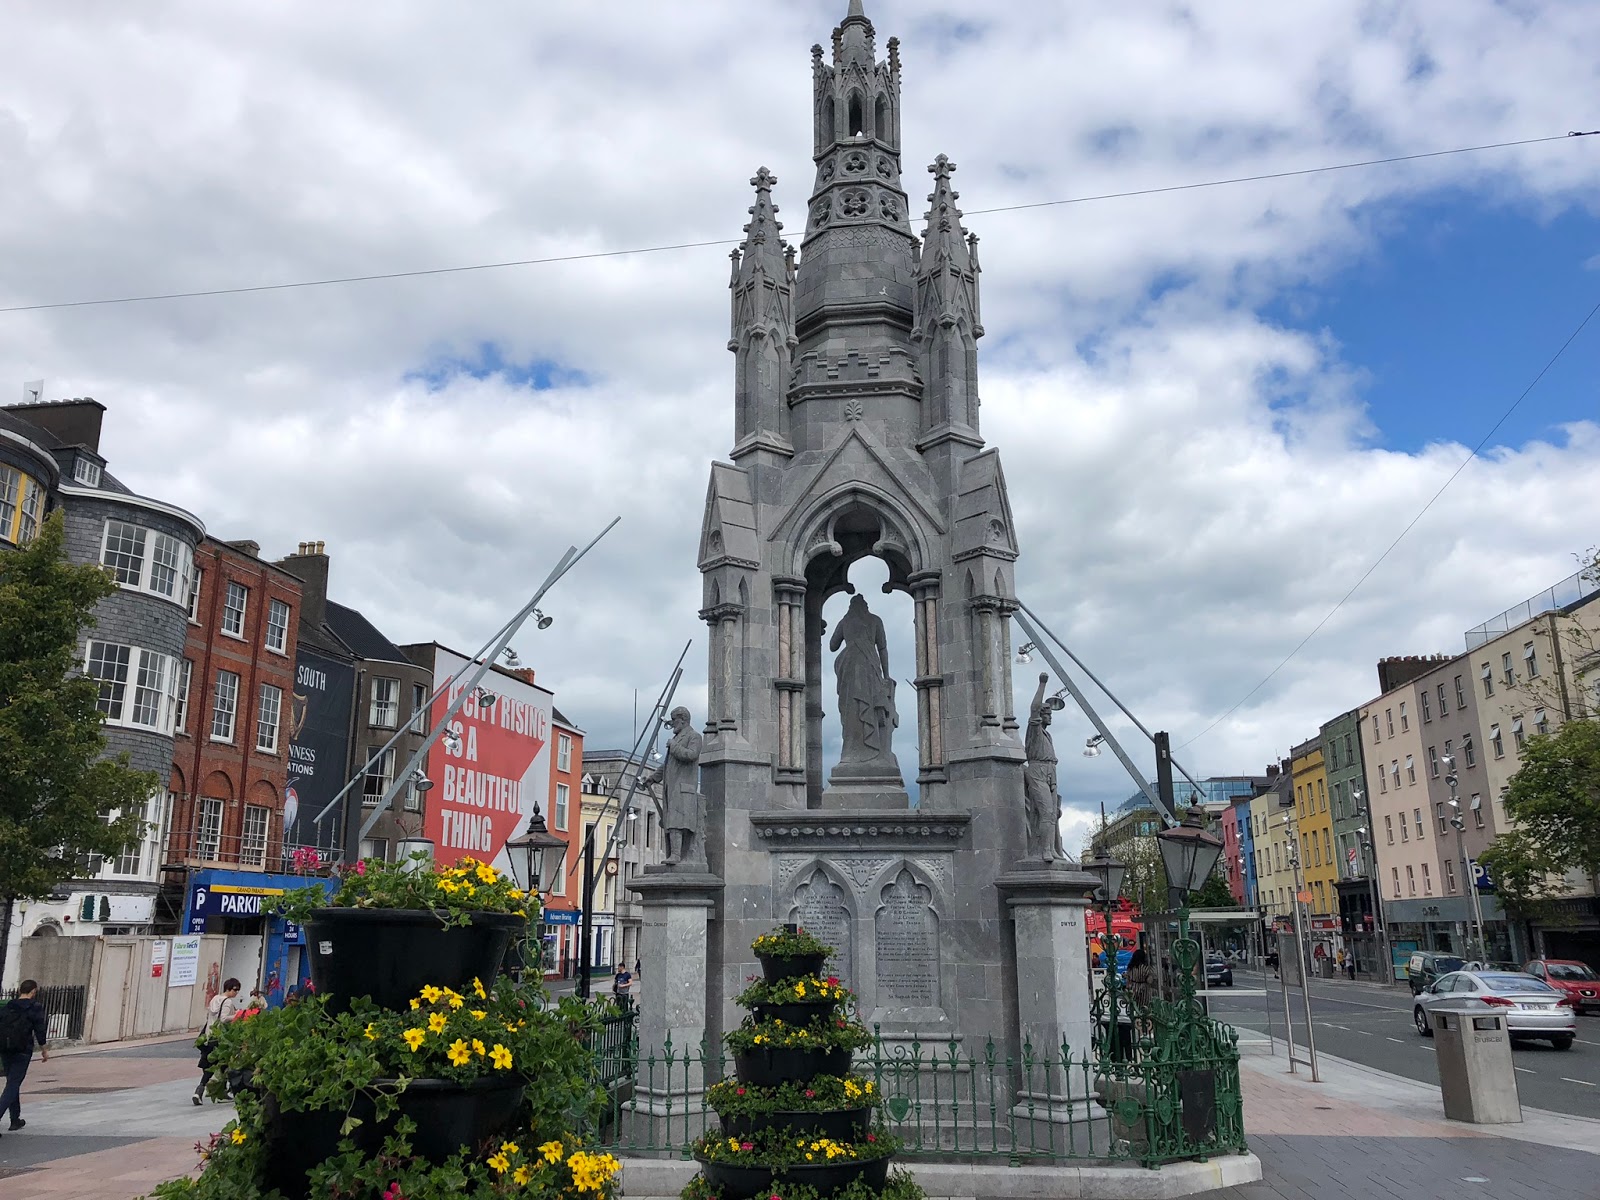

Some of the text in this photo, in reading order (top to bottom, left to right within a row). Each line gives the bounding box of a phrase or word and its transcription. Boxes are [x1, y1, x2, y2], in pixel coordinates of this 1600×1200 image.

[297, 665, 327, 691] SOUTH
[463, 682, 499, 725] CITY
[501, 695, 547, 742] RISING
[288, 744, 316, 762] NNESS
[446, 720, 478, 762] IS A
[287, 761, 314, 776] ATIONS
[443, 764, 524, 815] BEAUTIFUL
[441, 809, 492, 853] THING
[1203, 949, 1247, 960] TAXI
